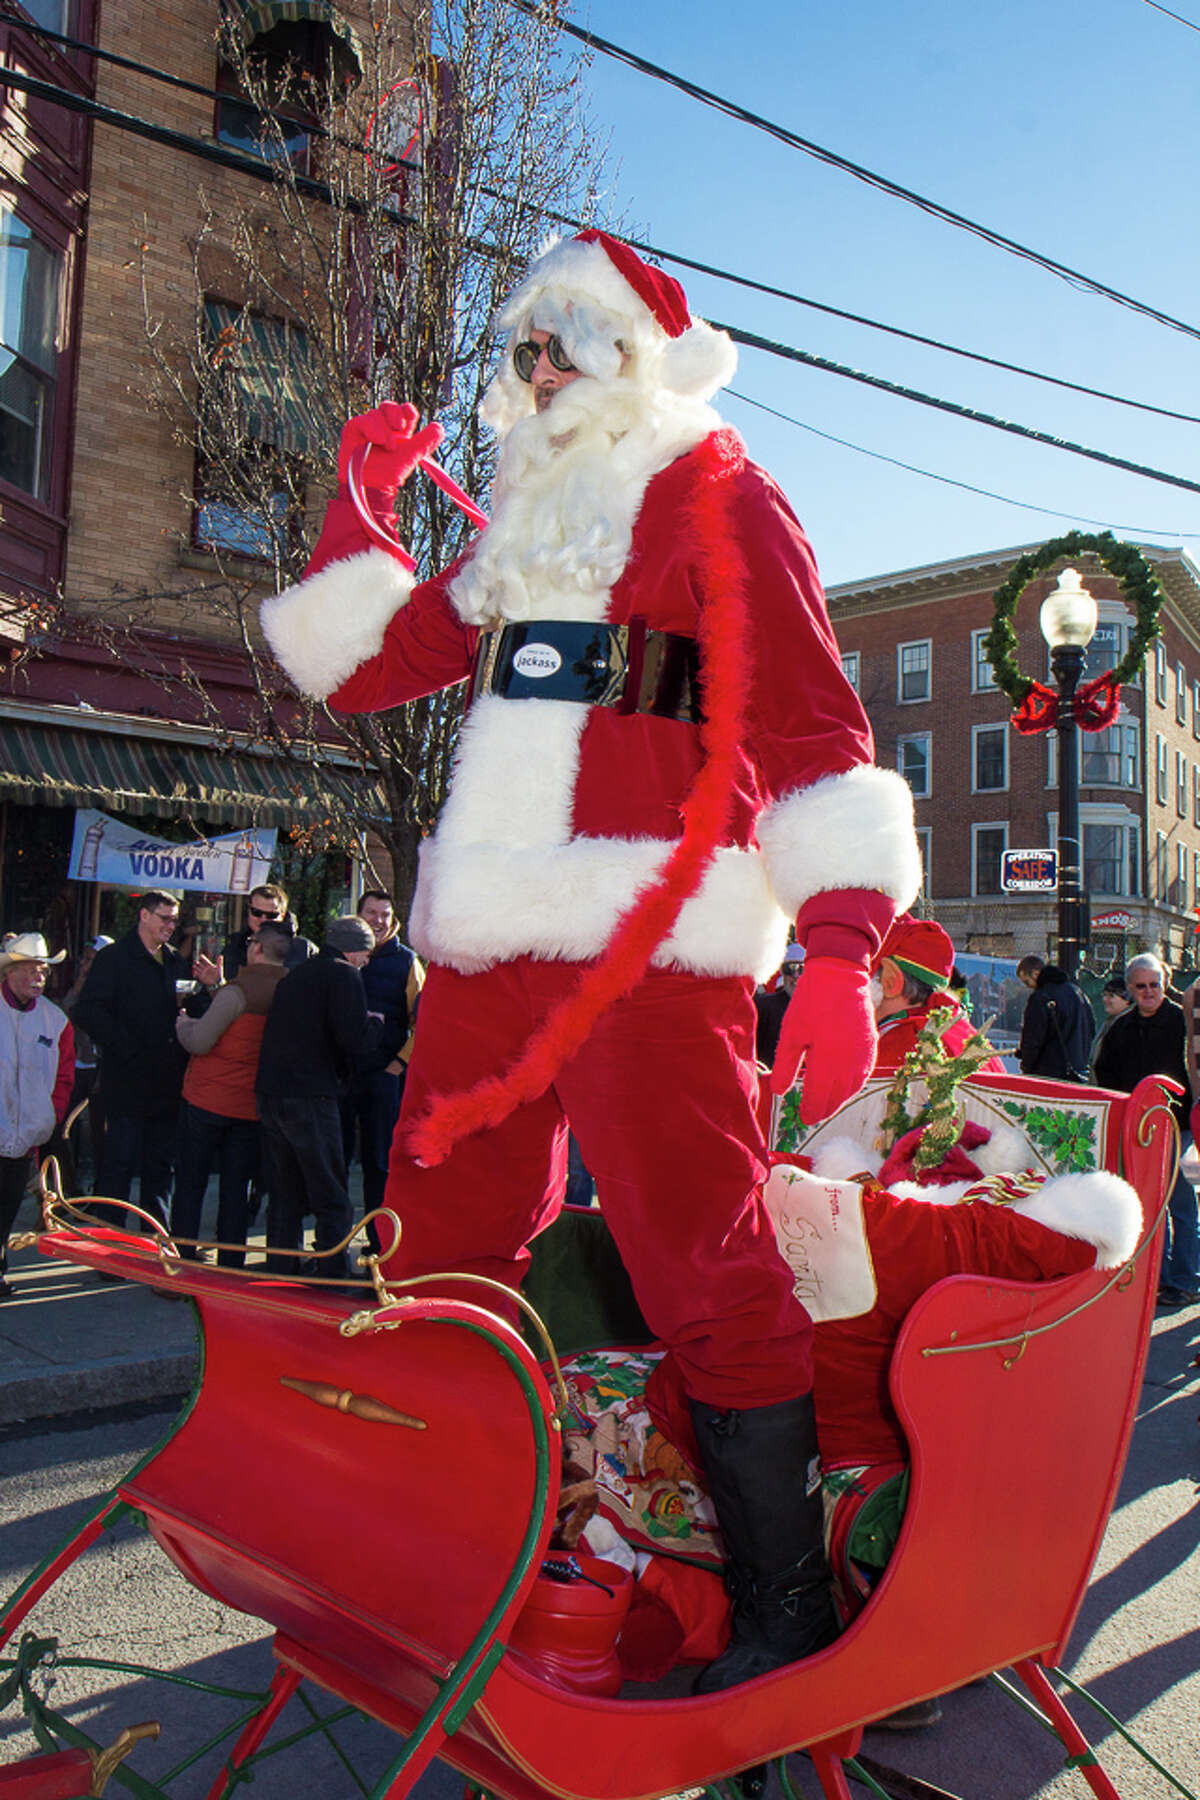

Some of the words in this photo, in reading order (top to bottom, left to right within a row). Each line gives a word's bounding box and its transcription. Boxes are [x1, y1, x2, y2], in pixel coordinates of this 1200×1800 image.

[517, 656, 557, 669] jackass
[129, 853, 204, 880] VODKA
[1011, 860, 1049, 880] SAFE
[1007, 879, 1053, 889] CORRIDOR
[780, 1211, 823, 1299] Santa
